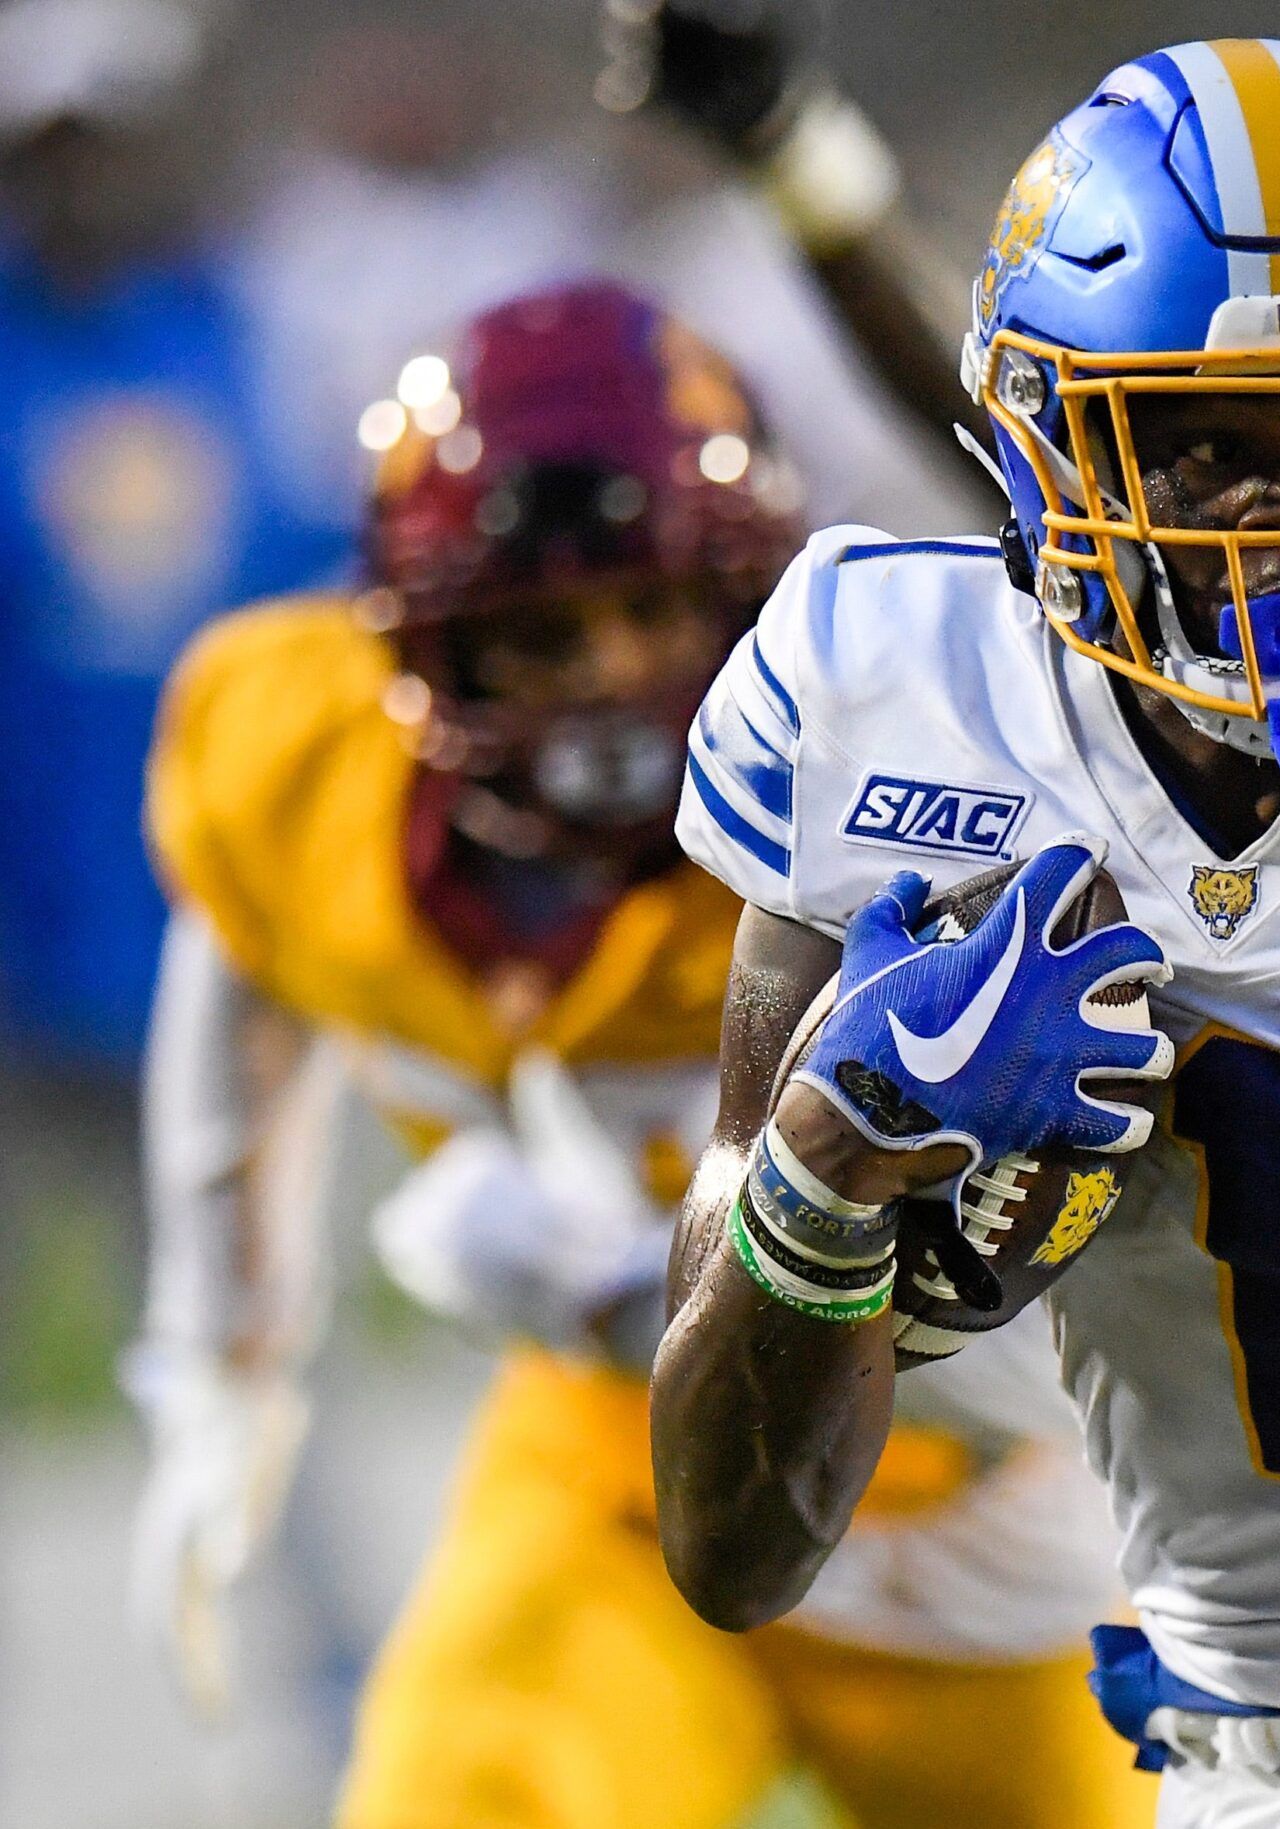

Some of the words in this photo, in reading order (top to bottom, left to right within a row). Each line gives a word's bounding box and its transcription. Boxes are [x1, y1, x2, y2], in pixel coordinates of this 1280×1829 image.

[855, 784, 1013, 846] SIAC
[796, 1204, 855, 1238] FORT
[770, 1285, 806, 1312] Not
[809, 1305, 871, 1321] Alone
